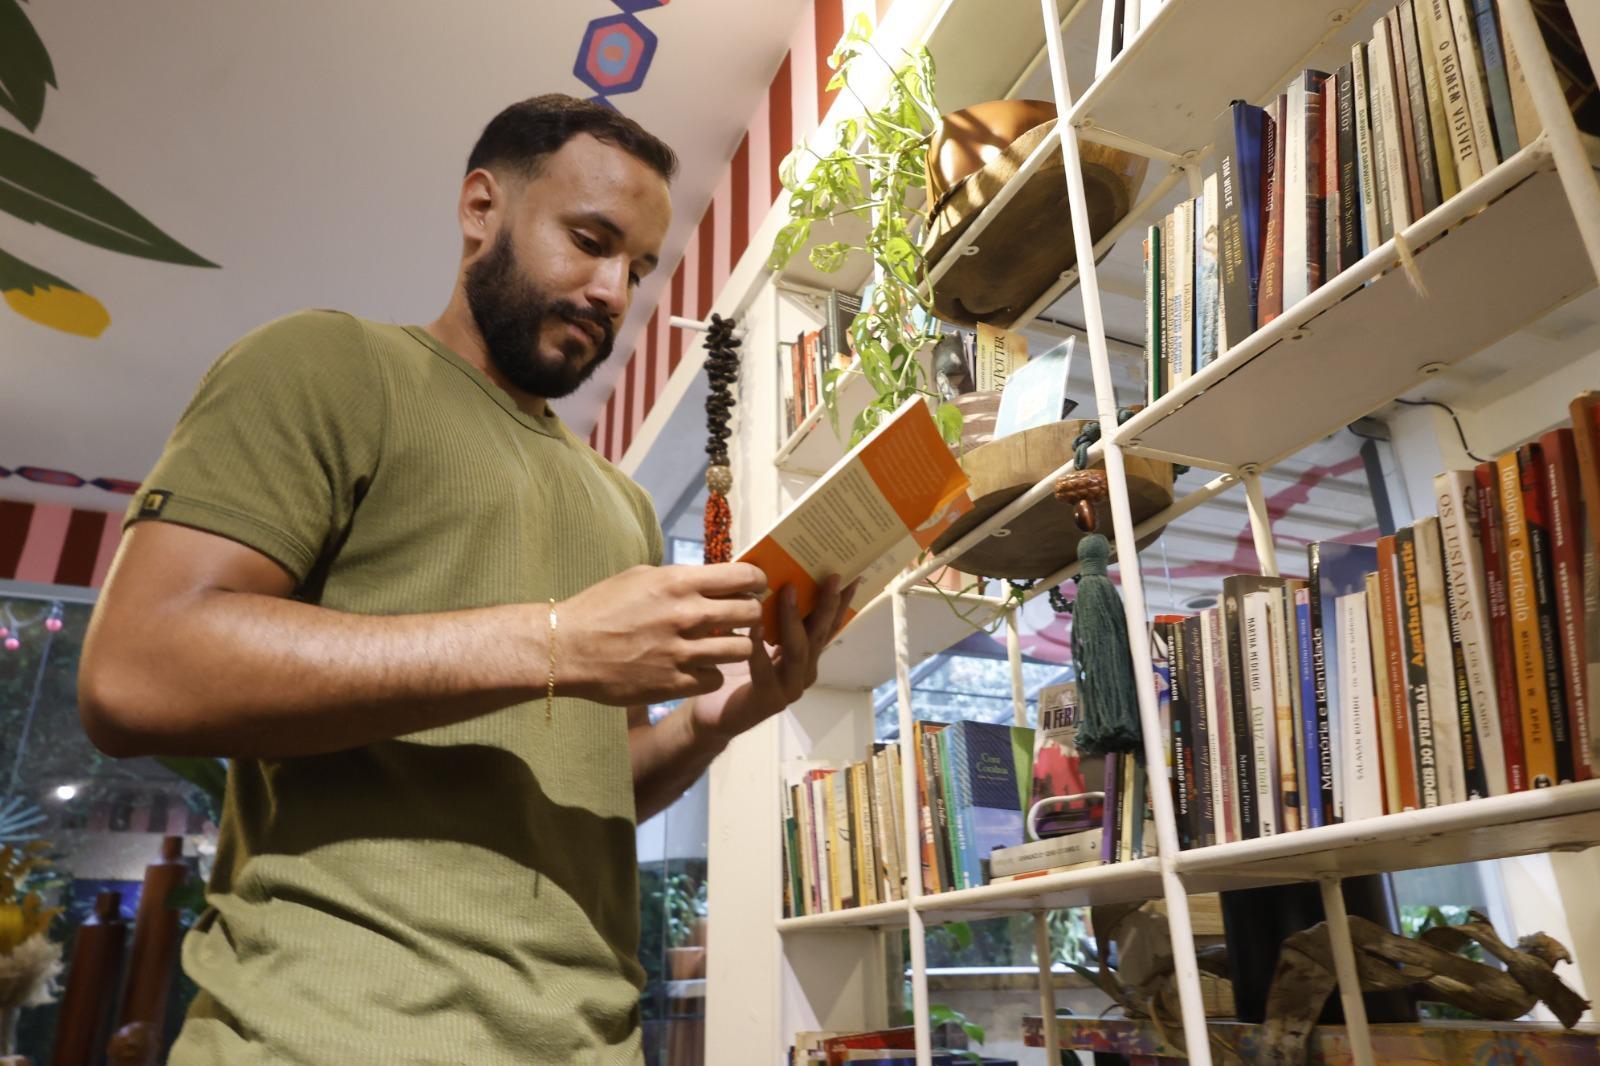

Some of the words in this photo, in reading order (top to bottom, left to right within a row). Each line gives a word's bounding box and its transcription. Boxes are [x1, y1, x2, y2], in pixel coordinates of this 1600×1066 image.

[1439, 40, 1450, 51] O
[1341, 80, 1351, 92] O
[1442, 54, 1462, 104] HOMEM
[1341, 94, 1352, 131] Leitor
[1358, 109, 1368, 141] DARWIN
[1452, 106, 1473, 161] VISÍVEL
[1222, 156, 1230, 177] TOM
[1344, 161, 1354, 207] BERNHARD
[1361, 155, 1373, 204] DARWINISMO
[1224, 177, 1233, 209] WOLFE
[1265, 173, 1276, 212] Young
[1266, 220, 1276, 261] Dublin
[1344, 209, 1354, 248] SCHLINK
[1265, 262, 1275, 298] Street
[1183, 283, 1191, 322] DEMIAN
[993, 336, 1006, 379] POTTER
[1174, 335, 1182, 374] AMORES
[1440, 494, 1452, 517] OS
[1503, 465, 1521, 536] Ideologia
[1510, 538, 1522, 547] e
[1402, 541, 1418, 606] Christie
[1445, 524, 1472, 621] LUSÍADAS
[1509, 549, 1530, 621] Currículo
[1559, 561, 1572, 613] EDUCAÇÃO
[1167, 635, 1175, 666] CARTAS
[1247, 617, 1257, 649] MARTHA
[1407, 607, 1424, 667] Agatha
[1541, 615, 1556, 670] EDUCAÇÃO
[1170, 666, 1177, 678] DE
[1250, 651, 1261, 692] MEDEIROS
[1548, 671, 1558, 687] EM
[1566, 623, 1582, 697] PARTICIPATIVA
[1171, 679, 1179, 701] AMOR
[1521, 630, 1535, 680] MICHAEL
[1530, 707, 1542, 743] APPLE
[1318, 707, 1328, 717] e
[1352, 696, 1362, 735] RUSHDIE
[1415, 683, 1433, 746] FUNERAL
[1460, 703, 1471, 733] NUNES
[1476, 689, 1491, 738] CAMÕES
[1551, 689, 1565, 742] INCLUSÃO
[1576, 699, 1591, 765] DEMOCRACIA
[1175, 737, 1185, 781] FERNANDO
[1318, 720, 1333, 790] Memória
[1355, 739, 1364, 780] SALMAN
[1420, 747, 1434, 766] DO
[1464, 734, 1475, 770] PEREIRA
[1179, 782, 1188, 815] PESSOA
[1242, 779, 1250, 793] del
